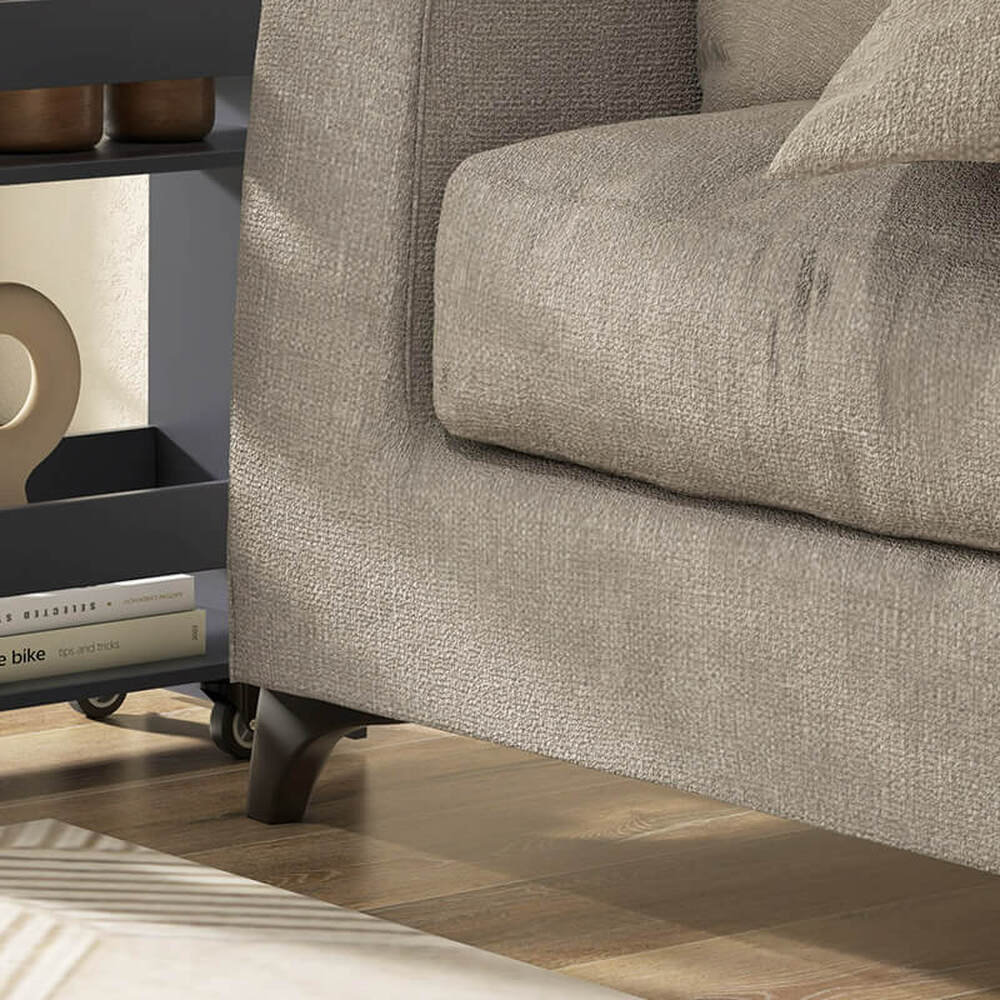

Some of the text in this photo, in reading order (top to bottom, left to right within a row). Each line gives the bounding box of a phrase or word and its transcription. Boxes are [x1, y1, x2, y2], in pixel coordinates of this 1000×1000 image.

[23, 601, 97, 621] SELECTED
[11, 647, 47, 666] bike
[75, 641, 95, 655] and
